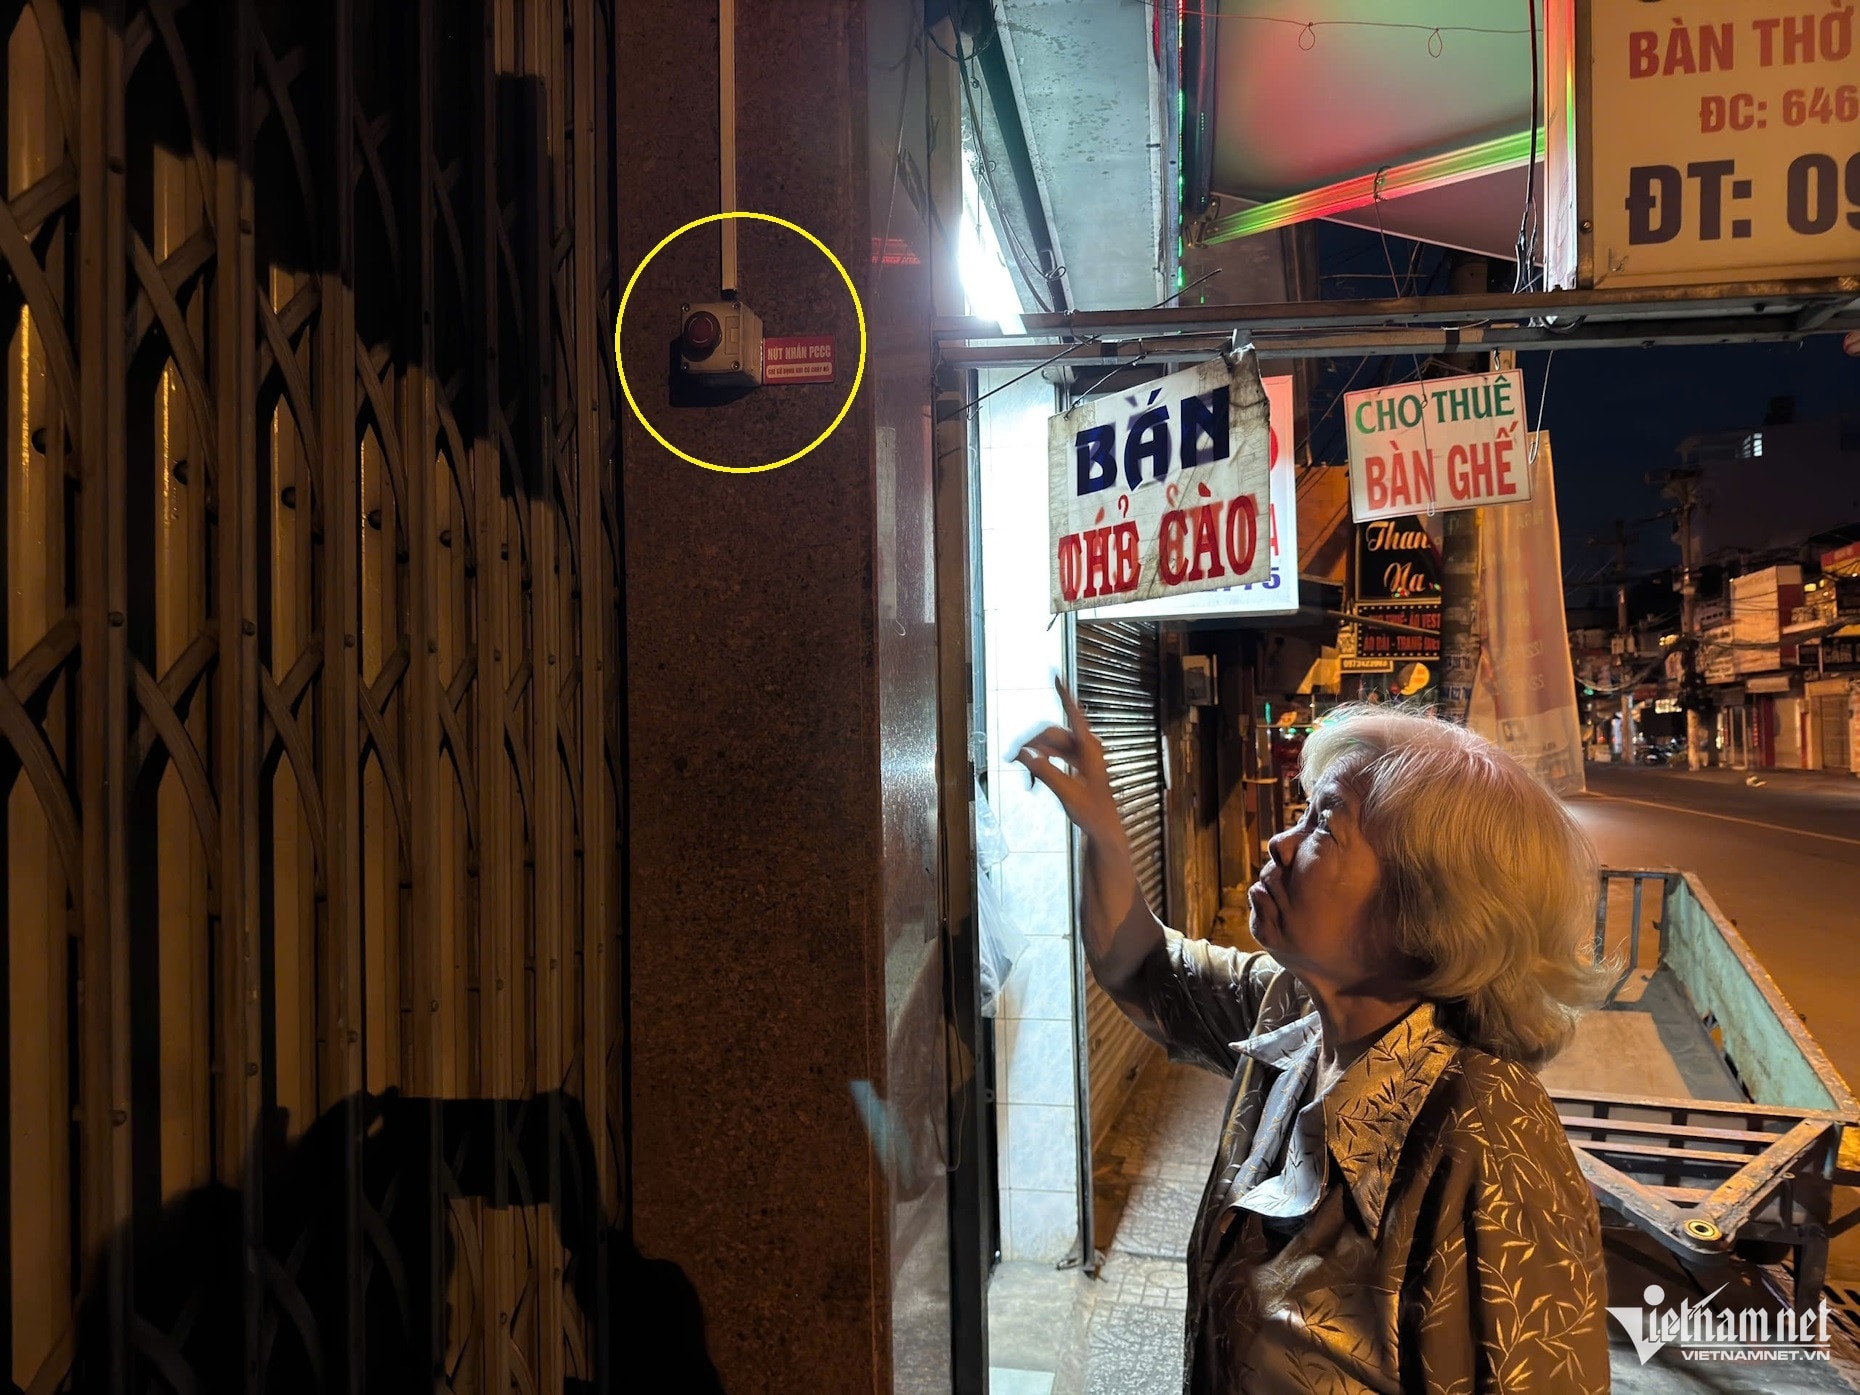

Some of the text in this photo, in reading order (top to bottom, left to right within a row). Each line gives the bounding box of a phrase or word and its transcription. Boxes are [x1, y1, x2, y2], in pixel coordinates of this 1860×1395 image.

[1629, 0, 1854, 79] BÀN THỜ
[1700, 85, 1859, 133] ĐC: 646
[1625, 159, 1752, 245] ĐT:
[767, 346, 783, 360] NÚT
[809, 345, 831, 358] PCCC
[1075, 385, 1230, 496] BÁN
[1355, 375, 1515, 434] CHO THUÊ
[1365, 421, 1518, 511] BÀN GHẾ
[1058, 495, 1141, 602] THẺ
[1158, 482, 1257, 586] CÀO
